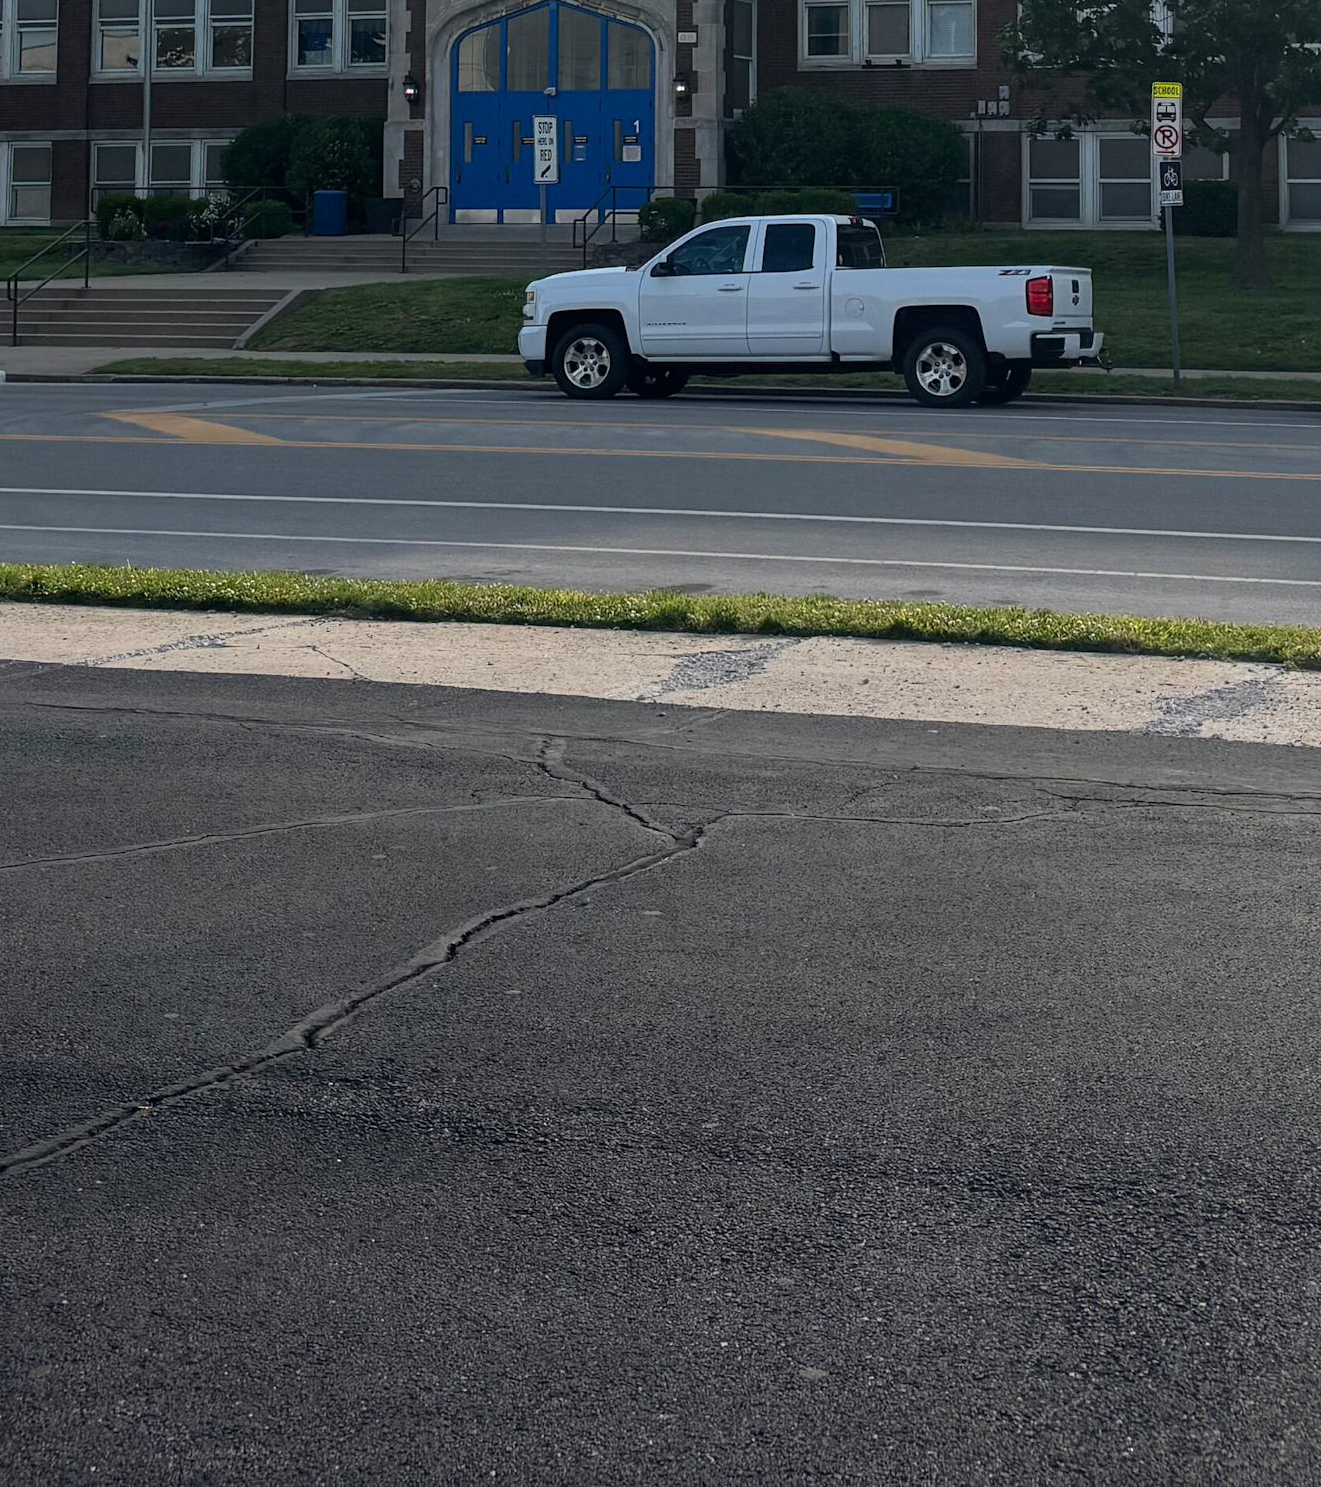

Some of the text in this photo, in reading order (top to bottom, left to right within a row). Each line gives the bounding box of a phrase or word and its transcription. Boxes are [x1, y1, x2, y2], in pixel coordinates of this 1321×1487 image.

[1153, 86, 1180, 95] SCHOOL
[538, 121, 553, 134] STOP
[633, 119, 640, 134] 1
[539, 149, 553, 162] RED
